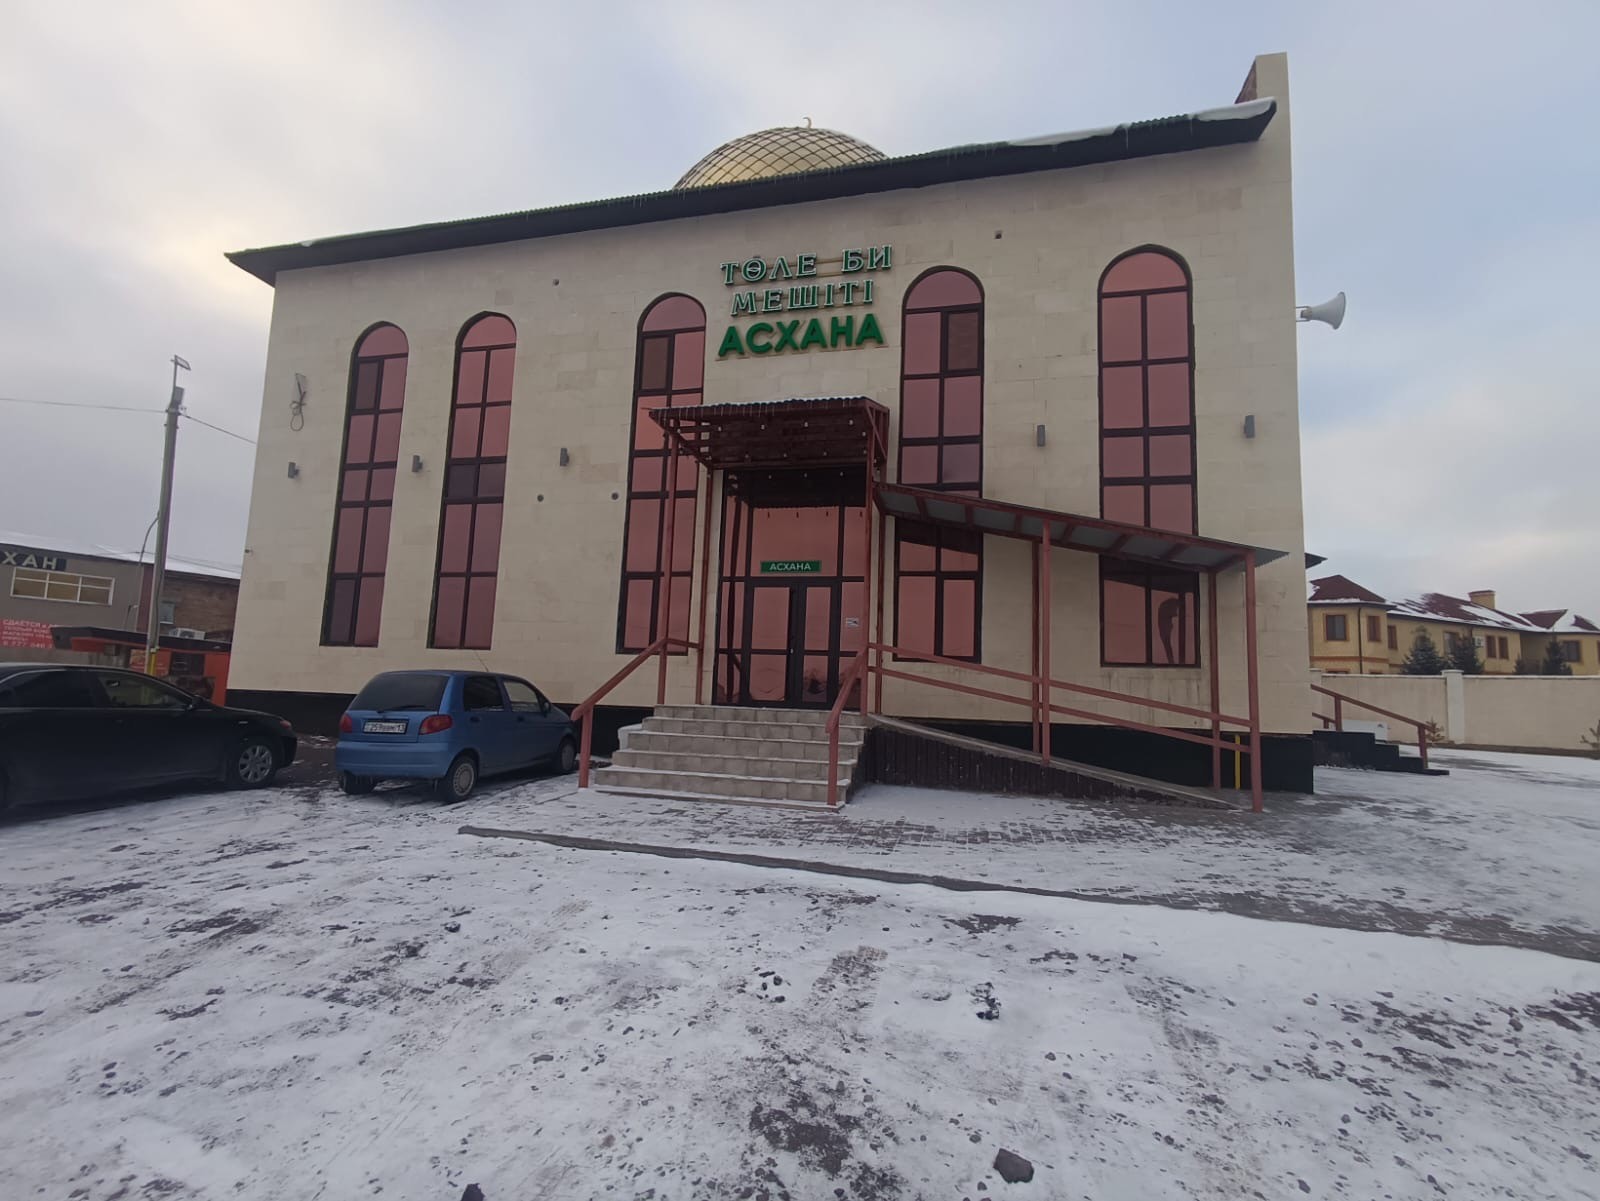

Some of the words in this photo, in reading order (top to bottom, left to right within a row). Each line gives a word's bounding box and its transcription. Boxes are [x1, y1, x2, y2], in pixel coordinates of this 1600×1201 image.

[720, 252, 817, 286] ТӨЛЕ
[841, 244, 892, 273] БИ
[731, 279, 873, 316] МЕШІТІ
[718, 313, 883, 357] АСХАНА
[769, 562, 811, 571] АСХАНА
